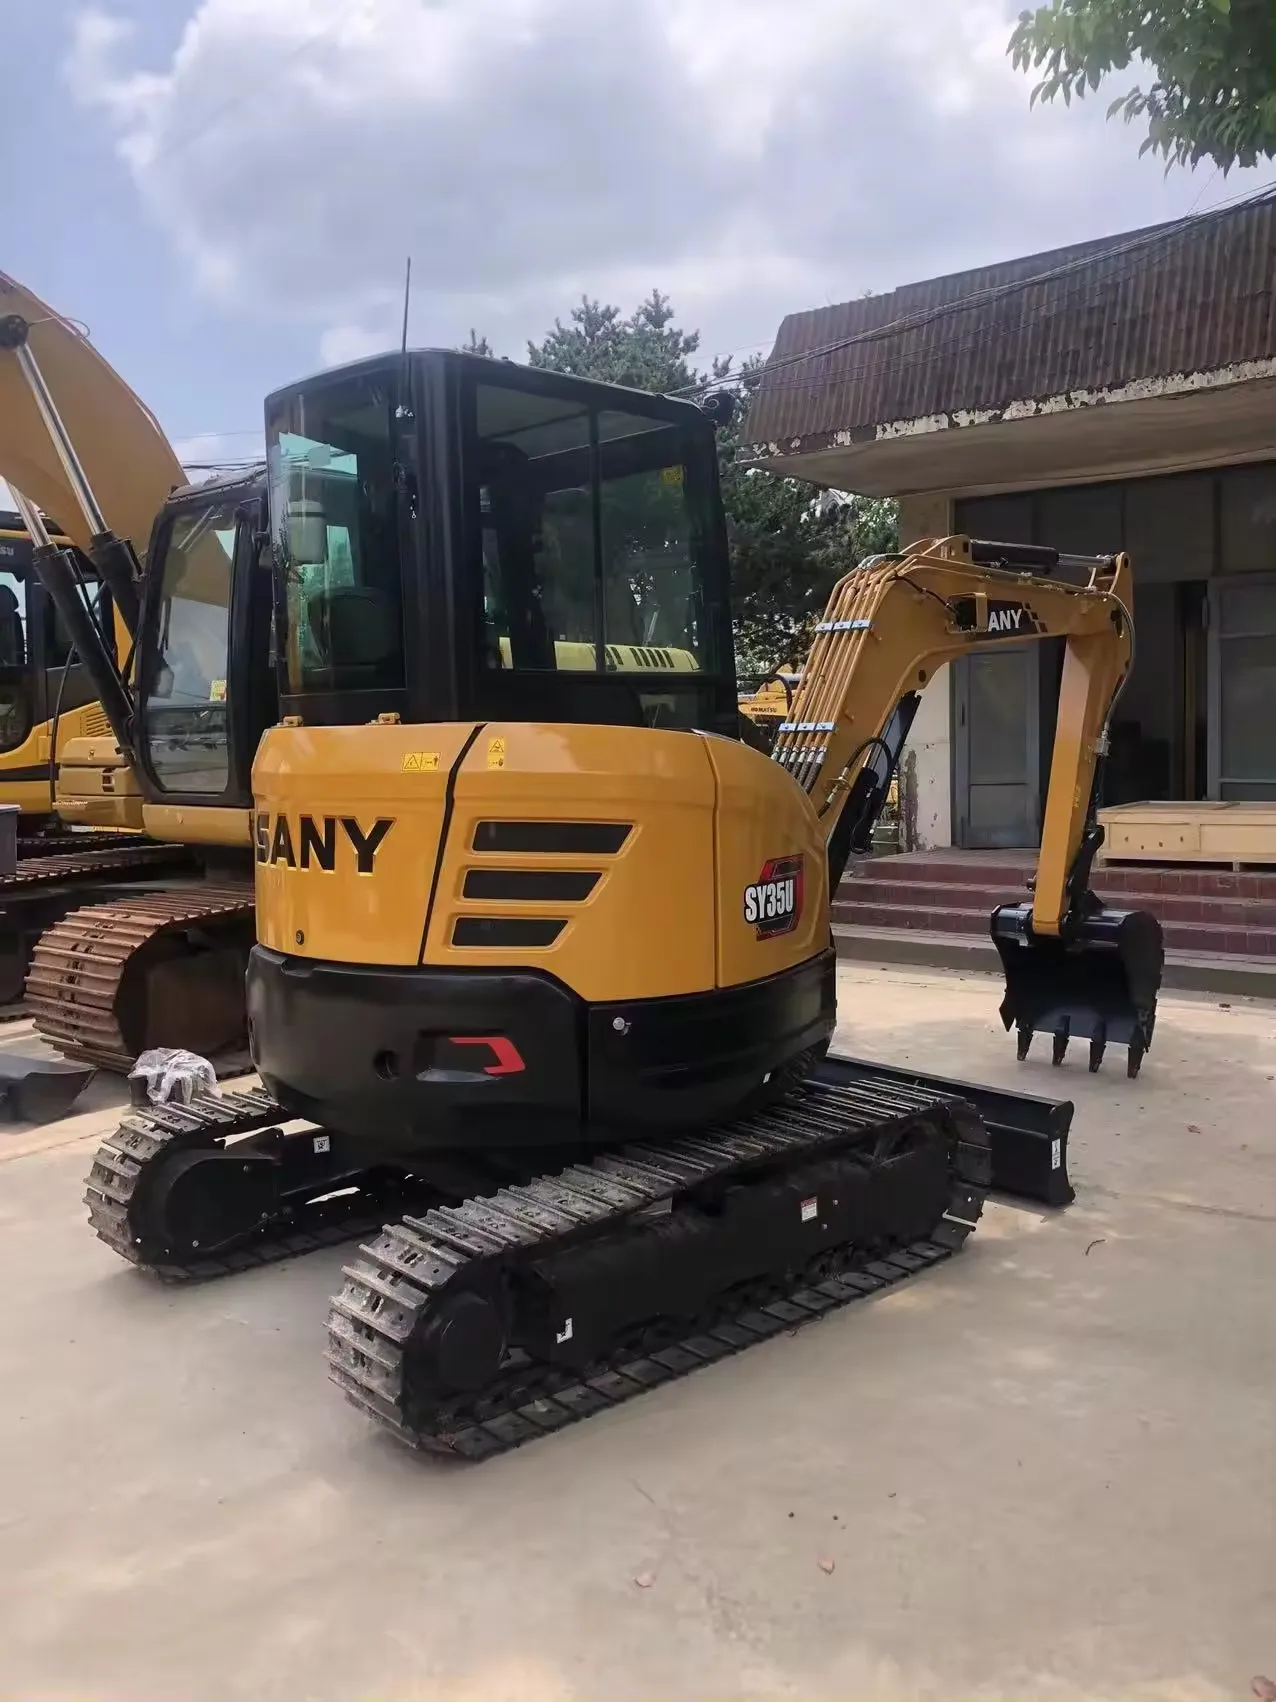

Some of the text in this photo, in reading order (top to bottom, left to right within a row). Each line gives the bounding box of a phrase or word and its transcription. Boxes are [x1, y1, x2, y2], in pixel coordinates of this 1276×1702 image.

[987, 608, 1023, 632] ANY
[256, 812, 397, 876] SANY
[744, 879, 794, 922] SY35U
